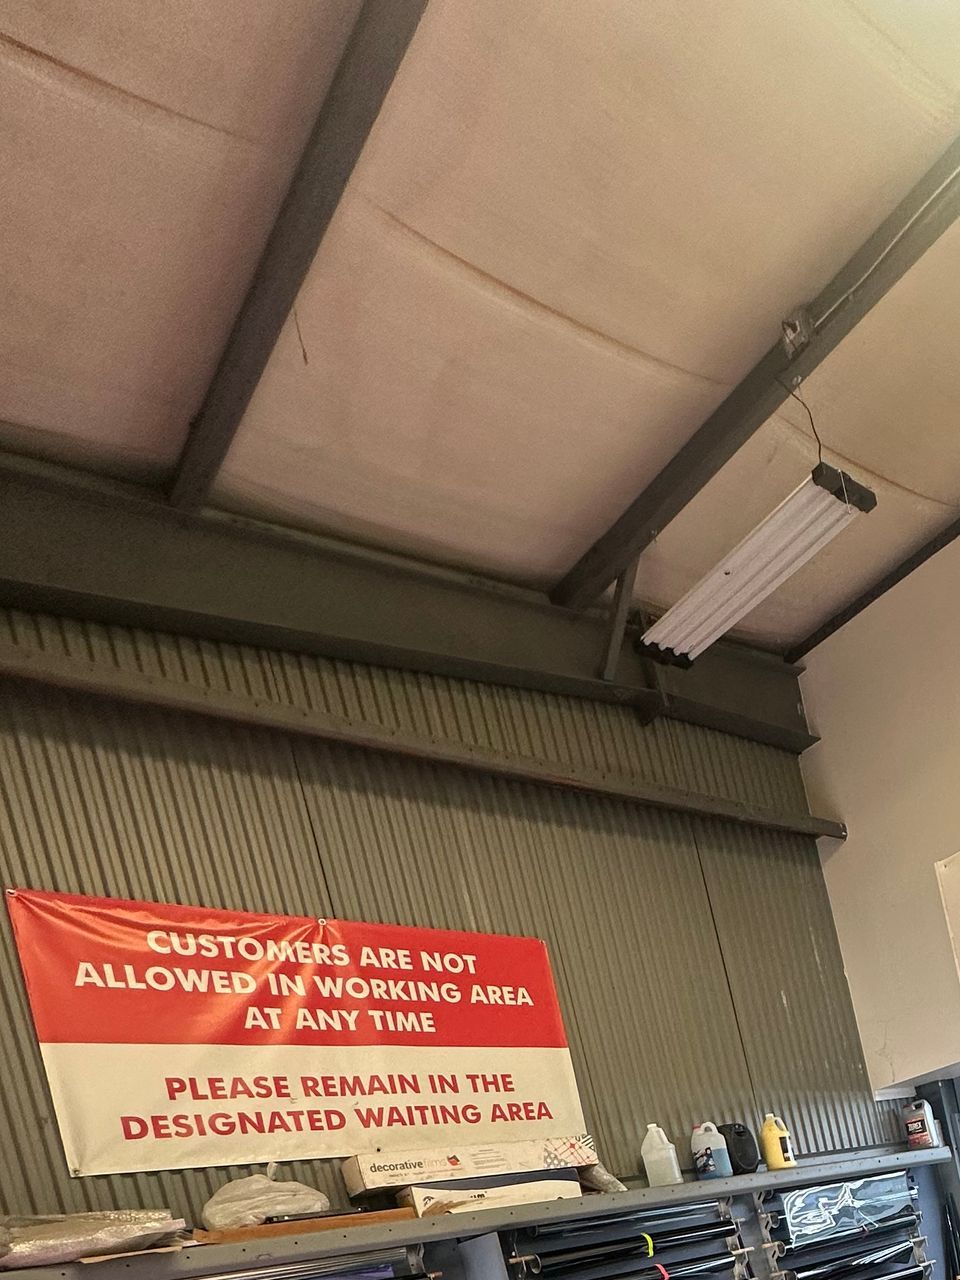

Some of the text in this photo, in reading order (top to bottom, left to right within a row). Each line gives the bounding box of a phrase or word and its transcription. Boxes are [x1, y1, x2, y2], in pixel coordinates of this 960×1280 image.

[146, 930, 477, 975] CUSTOMERS ARE NOT
[75, 962, 534, 1006] ALLOWED IN WORKING AREA
[244, 1007, 436, 1033] AT ANY TIME
[164, 1073, 516, 1100] PLEASE REMAIN IN THE
[119, 1101, 554, 1140] DESIGNATED WAITING AREA
